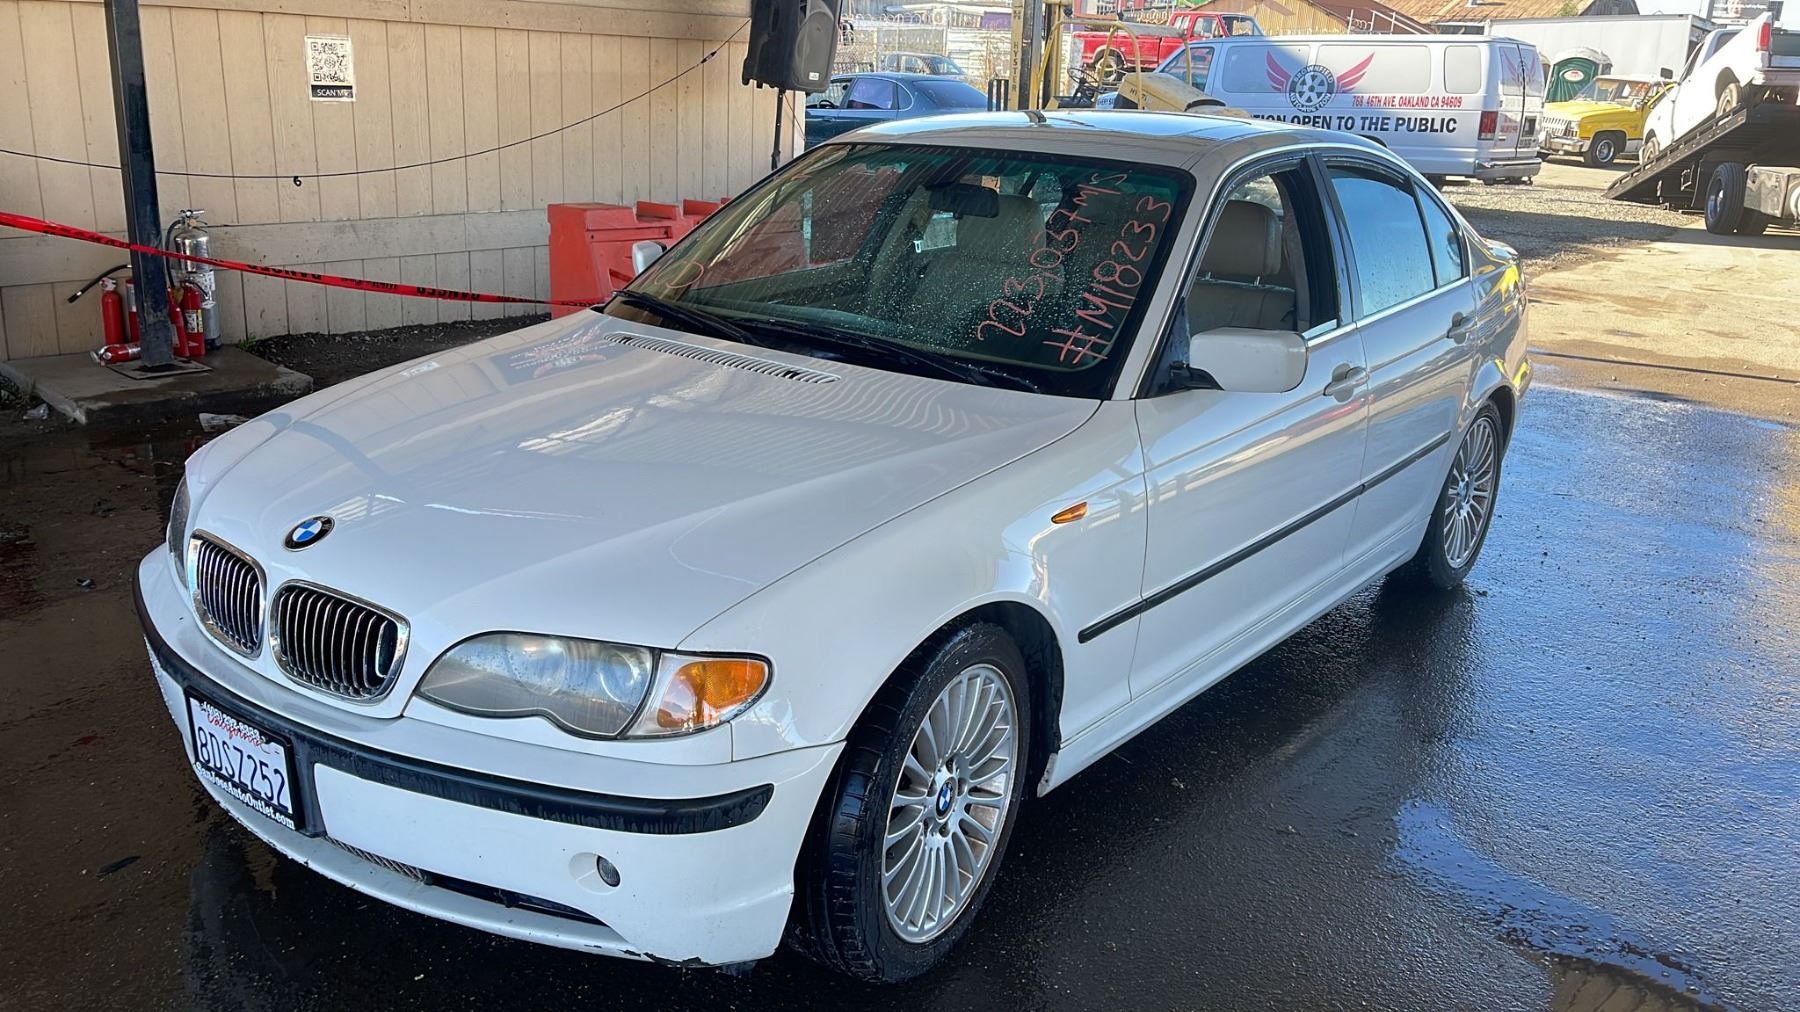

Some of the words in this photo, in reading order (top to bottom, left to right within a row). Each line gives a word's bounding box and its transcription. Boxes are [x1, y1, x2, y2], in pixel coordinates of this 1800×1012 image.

[1290, 115, 1332, 130] OPEN
[1336, 116, 1355, 131] TO
[1360, 116, 1391, 132] THE
[1394, 117, 1458, 133] PUBLIC
[1398, 96, 1430, 108] OAKLAND
[1431, 96, 1440, 108] CA
[1440, 96, 1463, 108] 94609
[1042, 196, 1171, 364] #M18233
[197, 726, 289, 812] 8DSZ252
